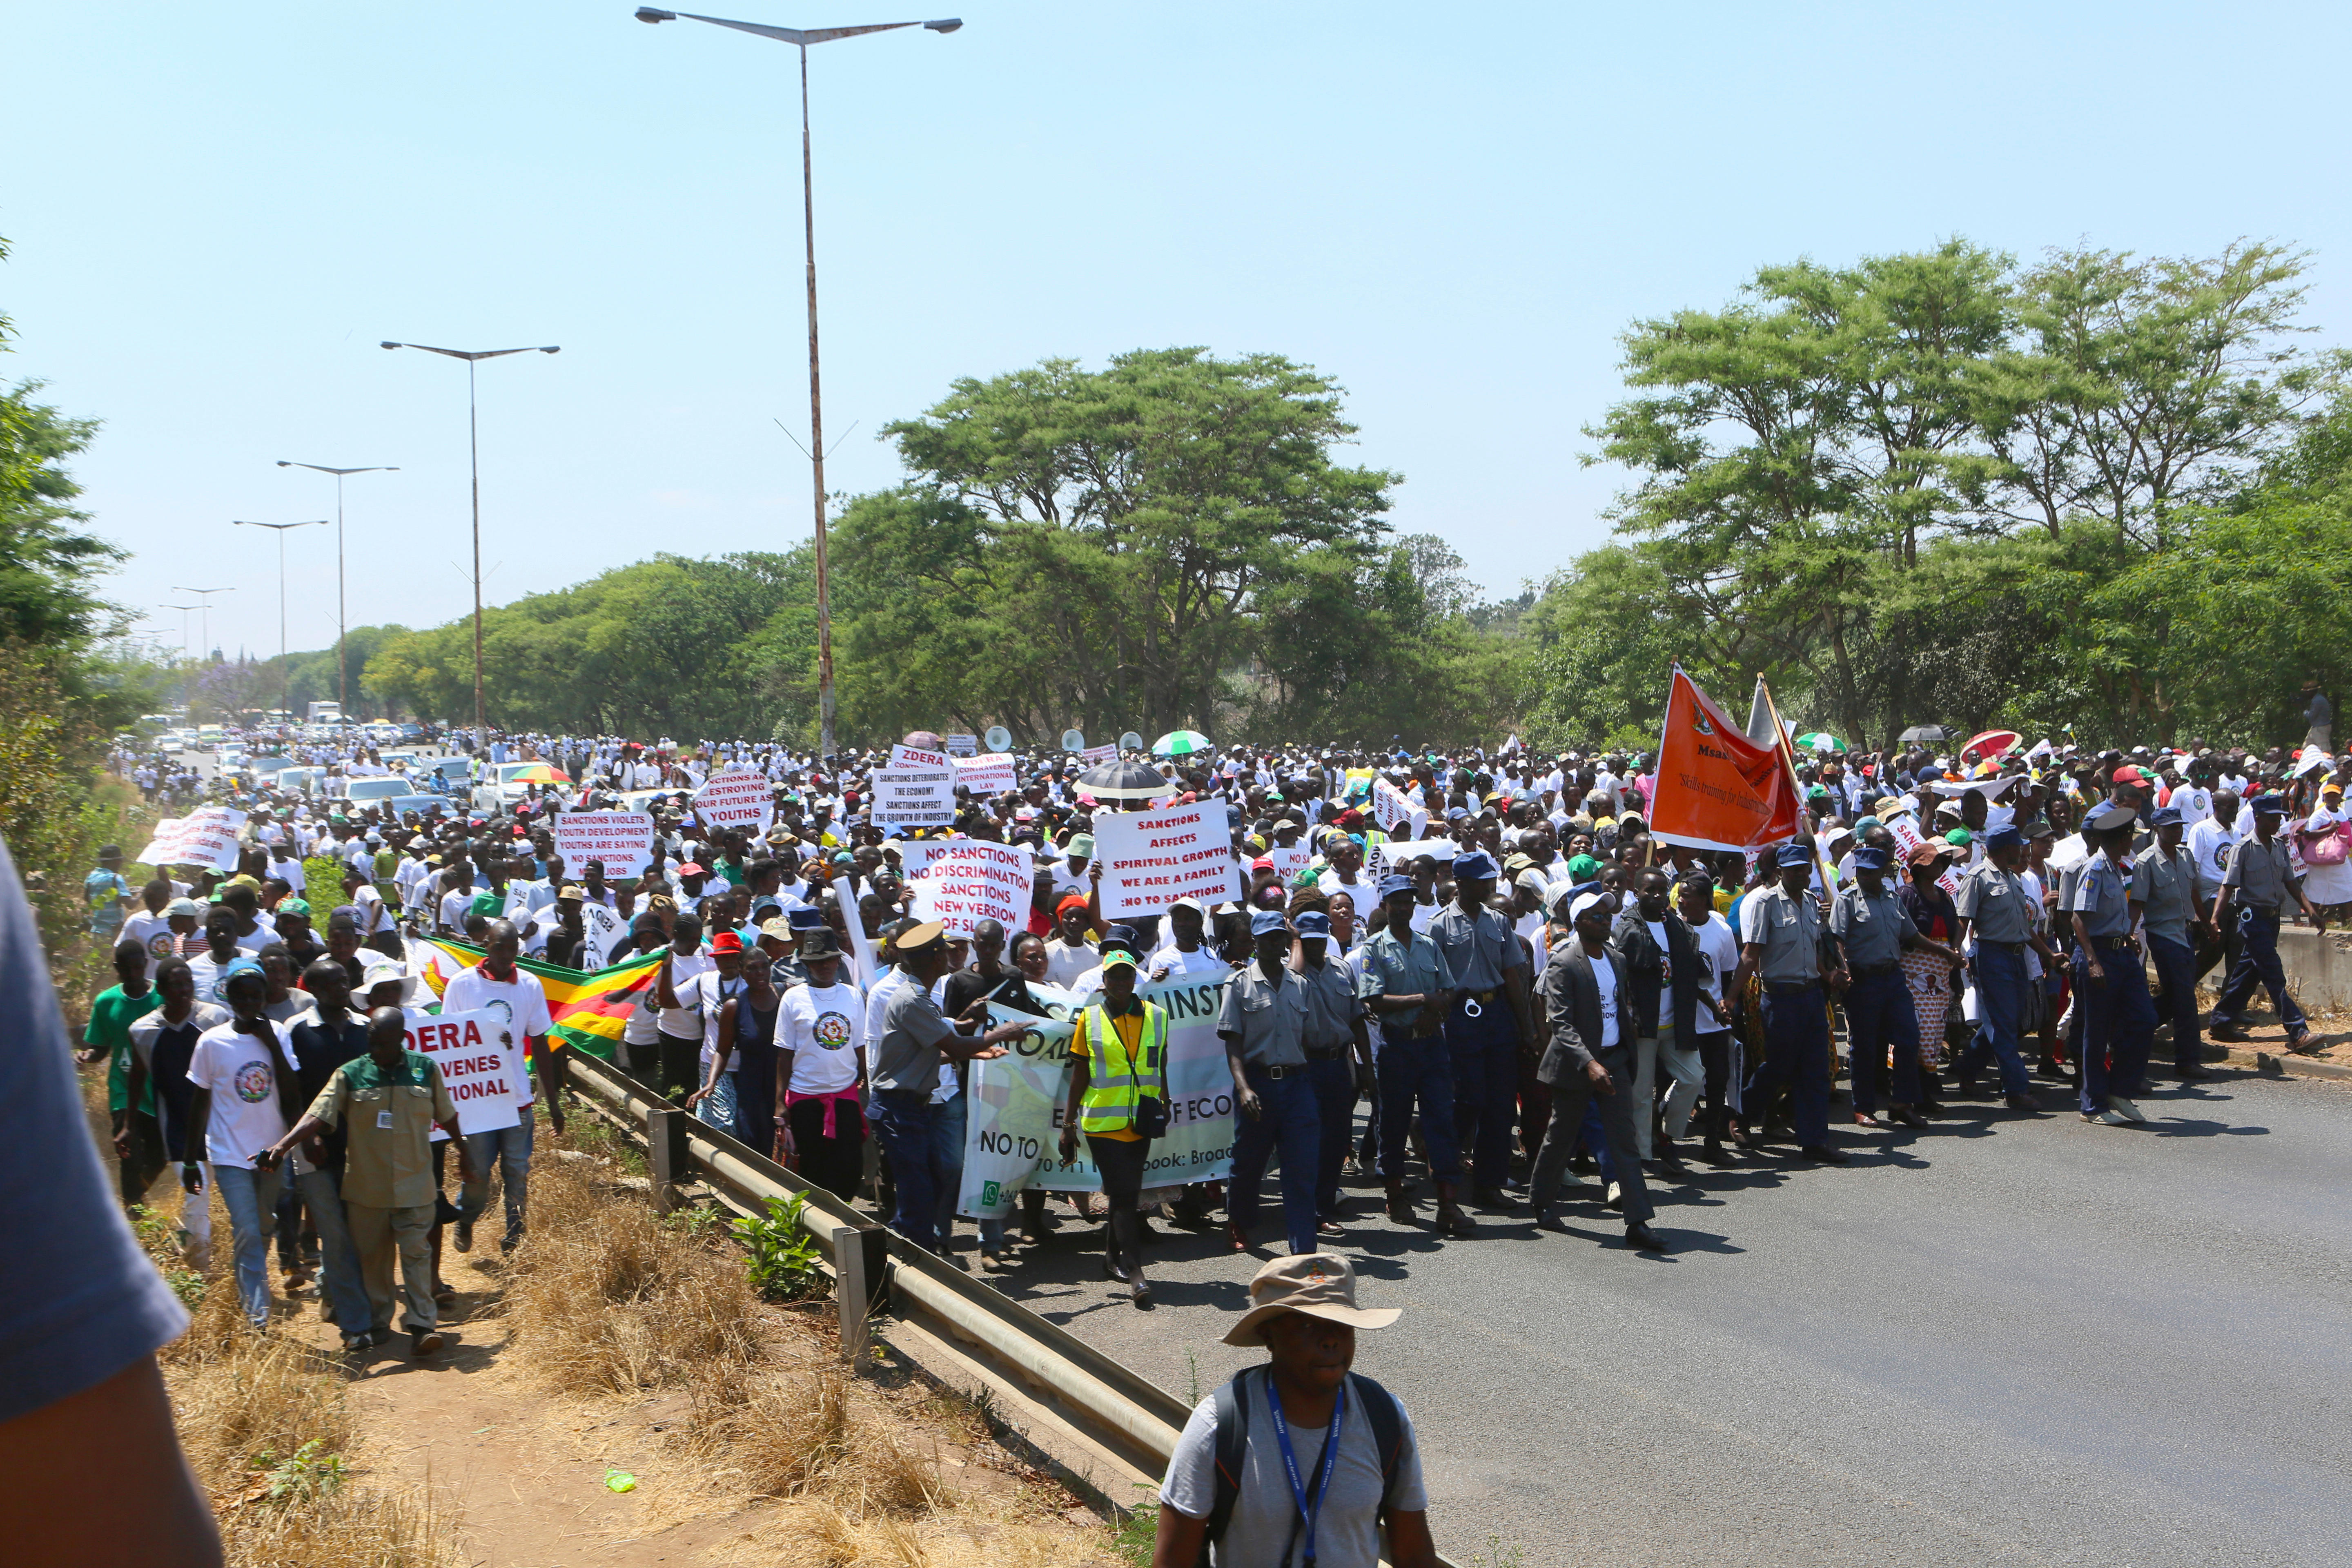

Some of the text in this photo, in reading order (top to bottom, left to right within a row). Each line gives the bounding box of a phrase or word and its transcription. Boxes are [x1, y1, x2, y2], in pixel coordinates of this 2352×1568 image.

[902, 749, 944, 766] ZDERA
[880, 773, 949, 783] SANCTIONS DETERIORATES
[958, 772, 1013, 783] INTERNATIONAL
[702, 783, 765, 796] ESTROYING
[894, 786, 935, 796] THE ECONOMY
[1702, 782, 1727, 804] training
[1726, 788, 1737, 806] for
[695, 800, 717, 808] OUR
[719, 796, 757, 806] FUTURE
[1377, 792, 1383, 802] to
[886, 800, 942, 809] SANCTIONS AFFECT
[1376, 803, 1383, 816] No
[561, 816, 645, 825] SANCTIONS VIOLETS
[709, 808, 761, 822] YOUTHS
[875, 812, 952, 822] THE GROWTH OF INDUSTRY
[1137, 813, 1200, 830] SANCTIONS
[588, 828, 649, 836] DEVELOPMENT
[560, 841, 593, 849] YOUTHS
[614, 840, 646, 849] SAYING
[1149, 833, 1197, 848] AFFECTS
[586, 854, 636, 863] SANCTIONS,
[925, 846, 1021, 871] NO SANCTIONS,
[1113, 846, 1228, 869] SPIRITUAL GROWTH
[1289, 853, 1301, 864] NO
[606, 867, 627, 876] JOBS
[1120, 865, 1225, 887] WE ARE A FAMILY
[1278, 867, 1291, 877] NO
[909, 865, 1030, 893] NO DISCRIMINATION
[941, 882, 1011, 904] SANCTIONS
[1120, 884, 1225, 907] :NO TO SANCTIONS
[934, 900, 1016, 925] NEW VERSION
[941, 917, 958, 930] OF
[441, 1054, 501, 1078] VENES
[1187, 1095, 1232, 1120] ECO
[980, 1130, 1038, 1159] NO TO
